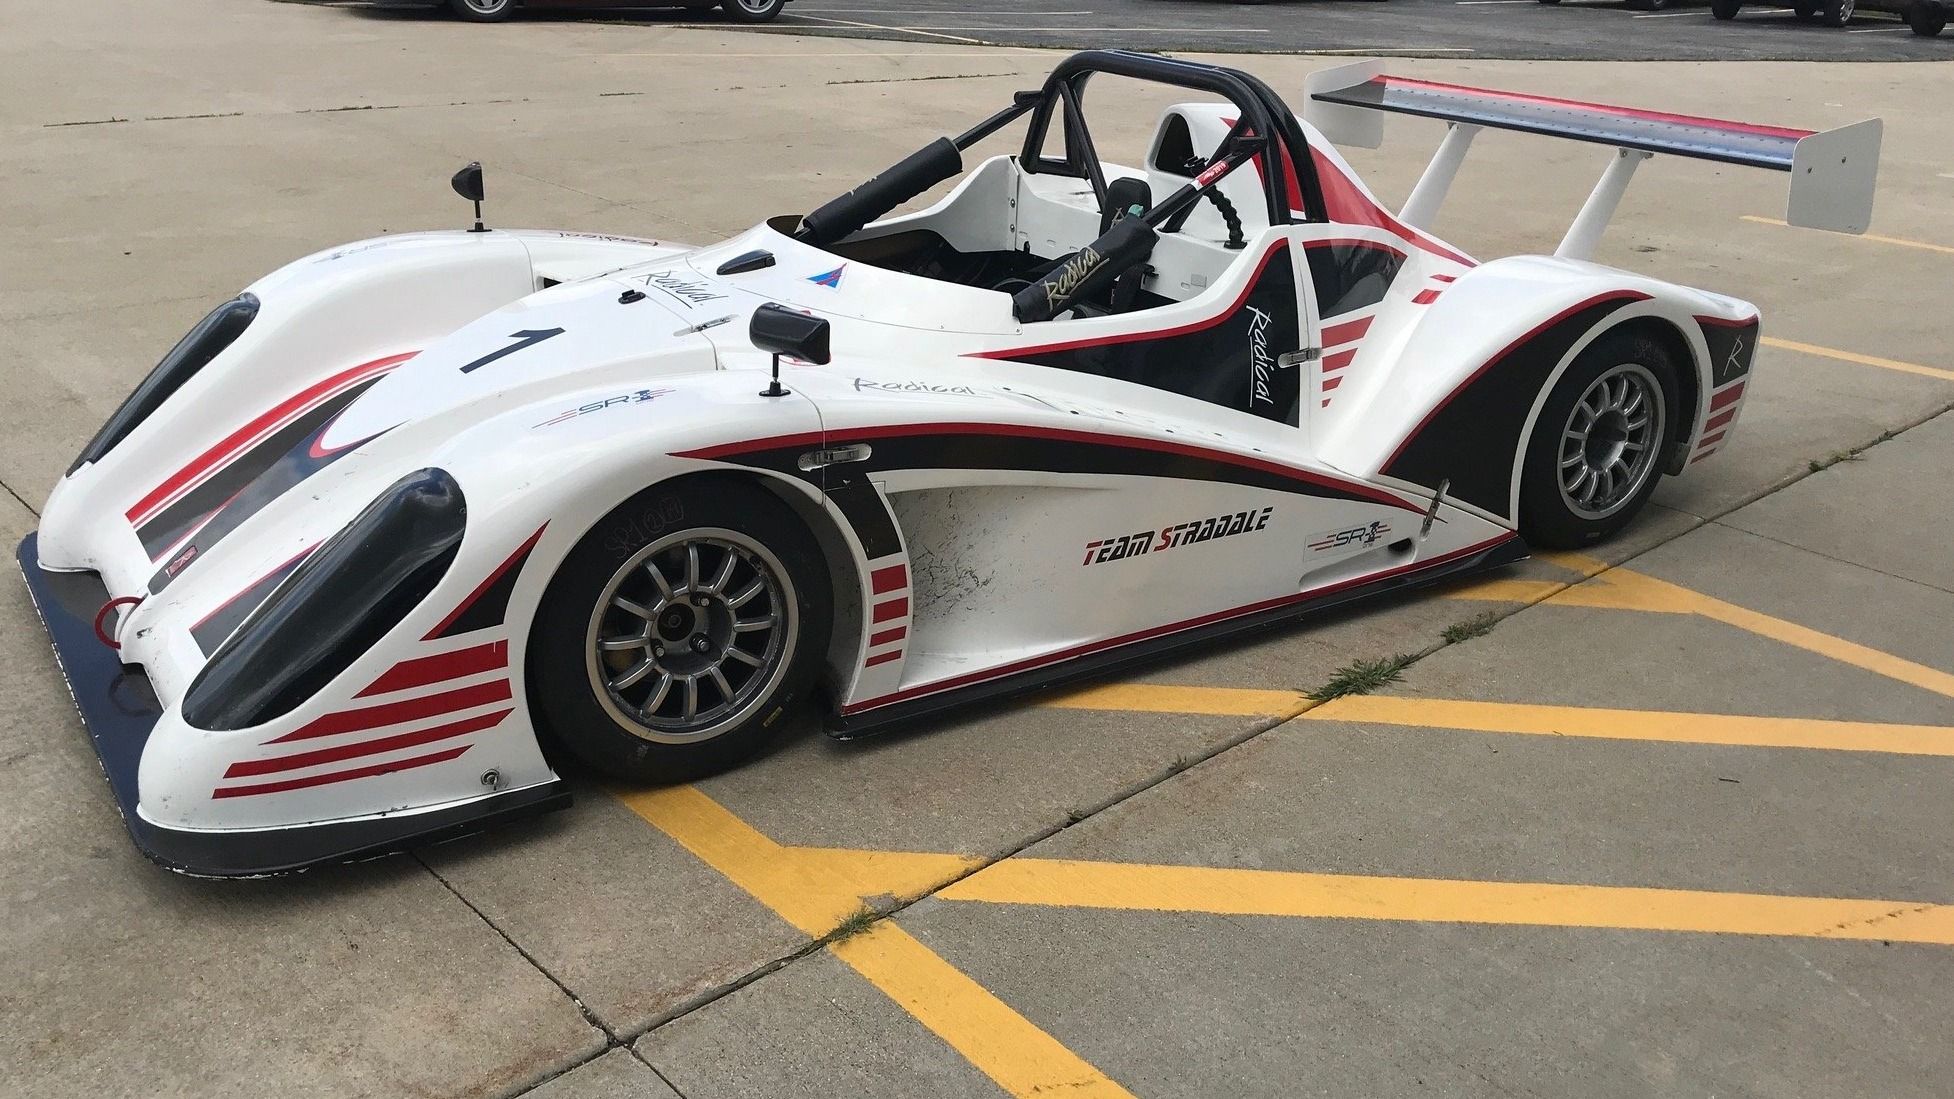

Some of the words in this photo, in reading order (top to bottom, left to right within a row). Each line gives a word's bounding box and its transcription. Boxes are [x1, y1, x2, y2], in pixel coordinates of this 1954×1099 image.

[632, 270, 729, 310] Radical
[1040, 246, 1103, 312] Radical
[459, 327, 566, 374] 1
[1246, 305, 1275, 407] Radical
[1722, 334, 1744, 377] R
[853, 377, 978, 397] Radical
[1083, 530, 1155, 566] TEAM
[1154, 506, 1273, 552] STRADALE
